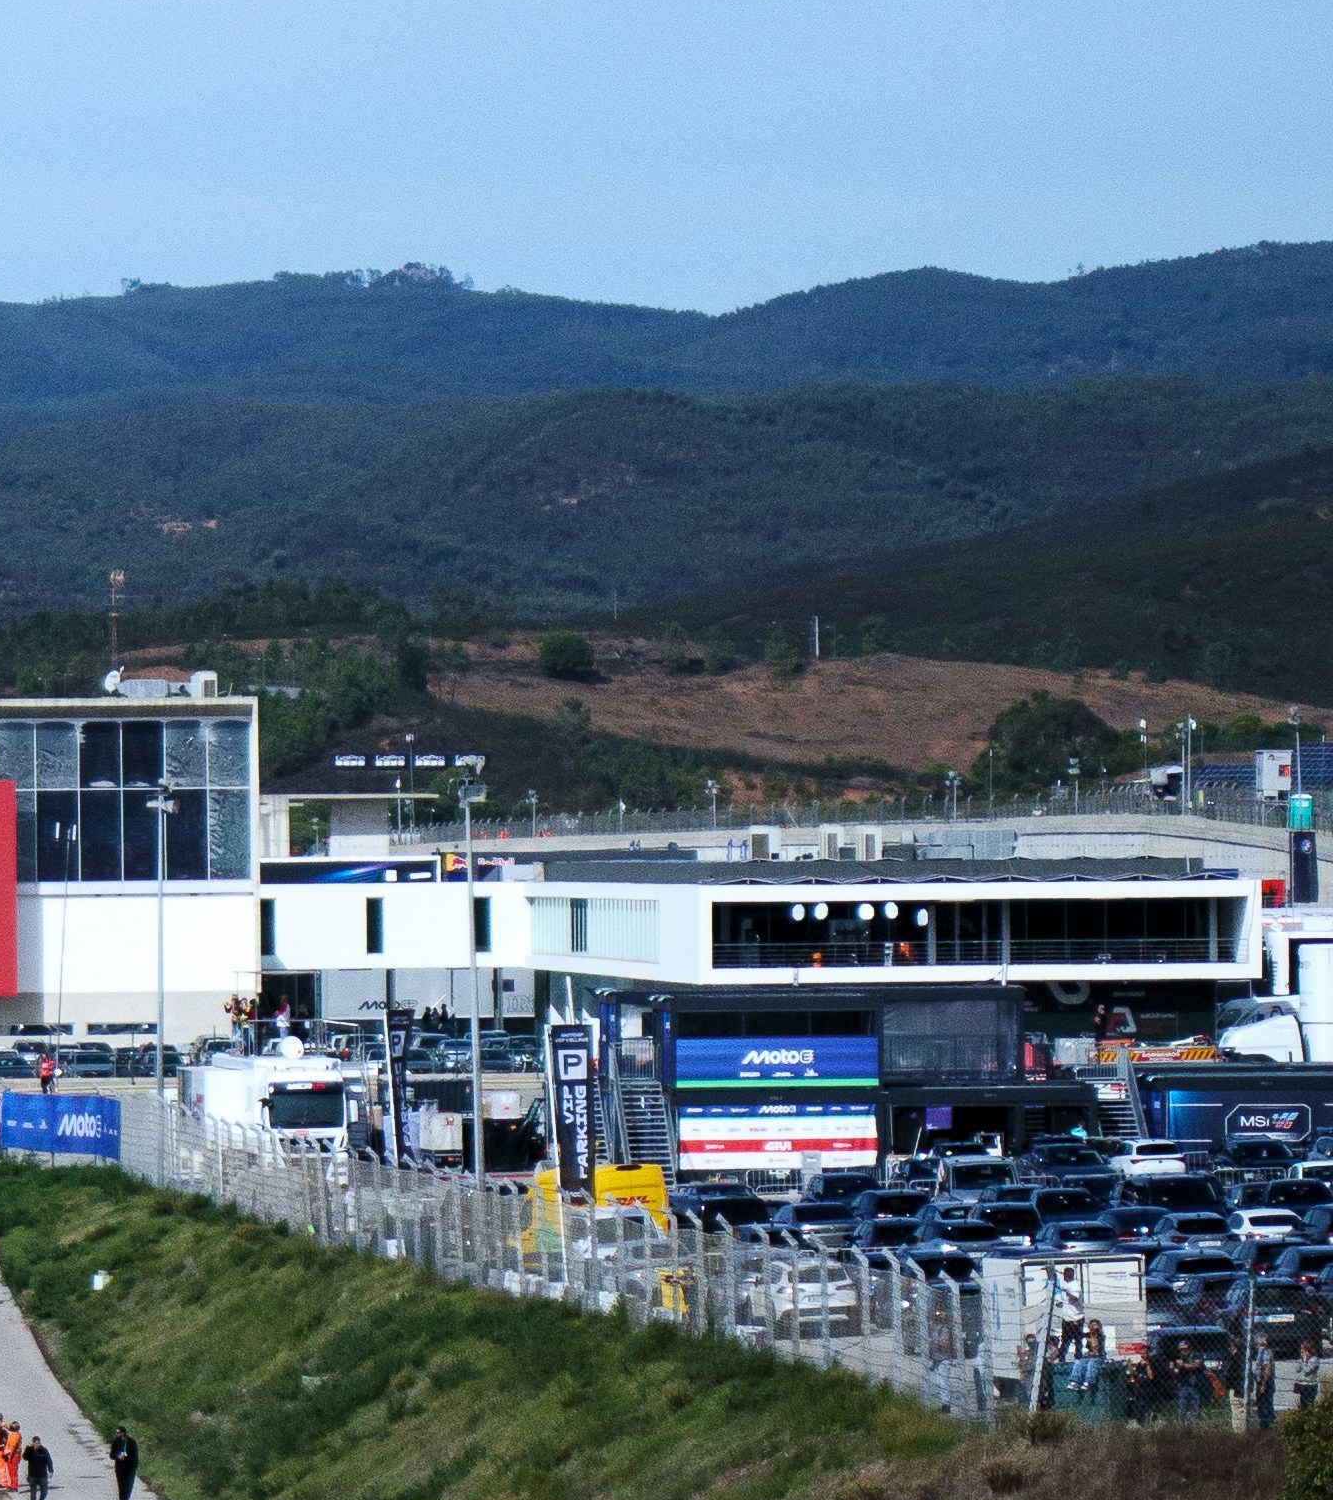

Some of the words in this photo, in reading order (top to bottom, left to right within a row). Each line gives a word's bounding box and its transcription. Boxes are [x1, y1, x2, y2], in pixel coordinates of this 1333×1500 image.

[564, 1054, 582, 1074] P
[563, 1086, 574, 1124] VIP
[575, 1085, 588, 1178] PARKING
